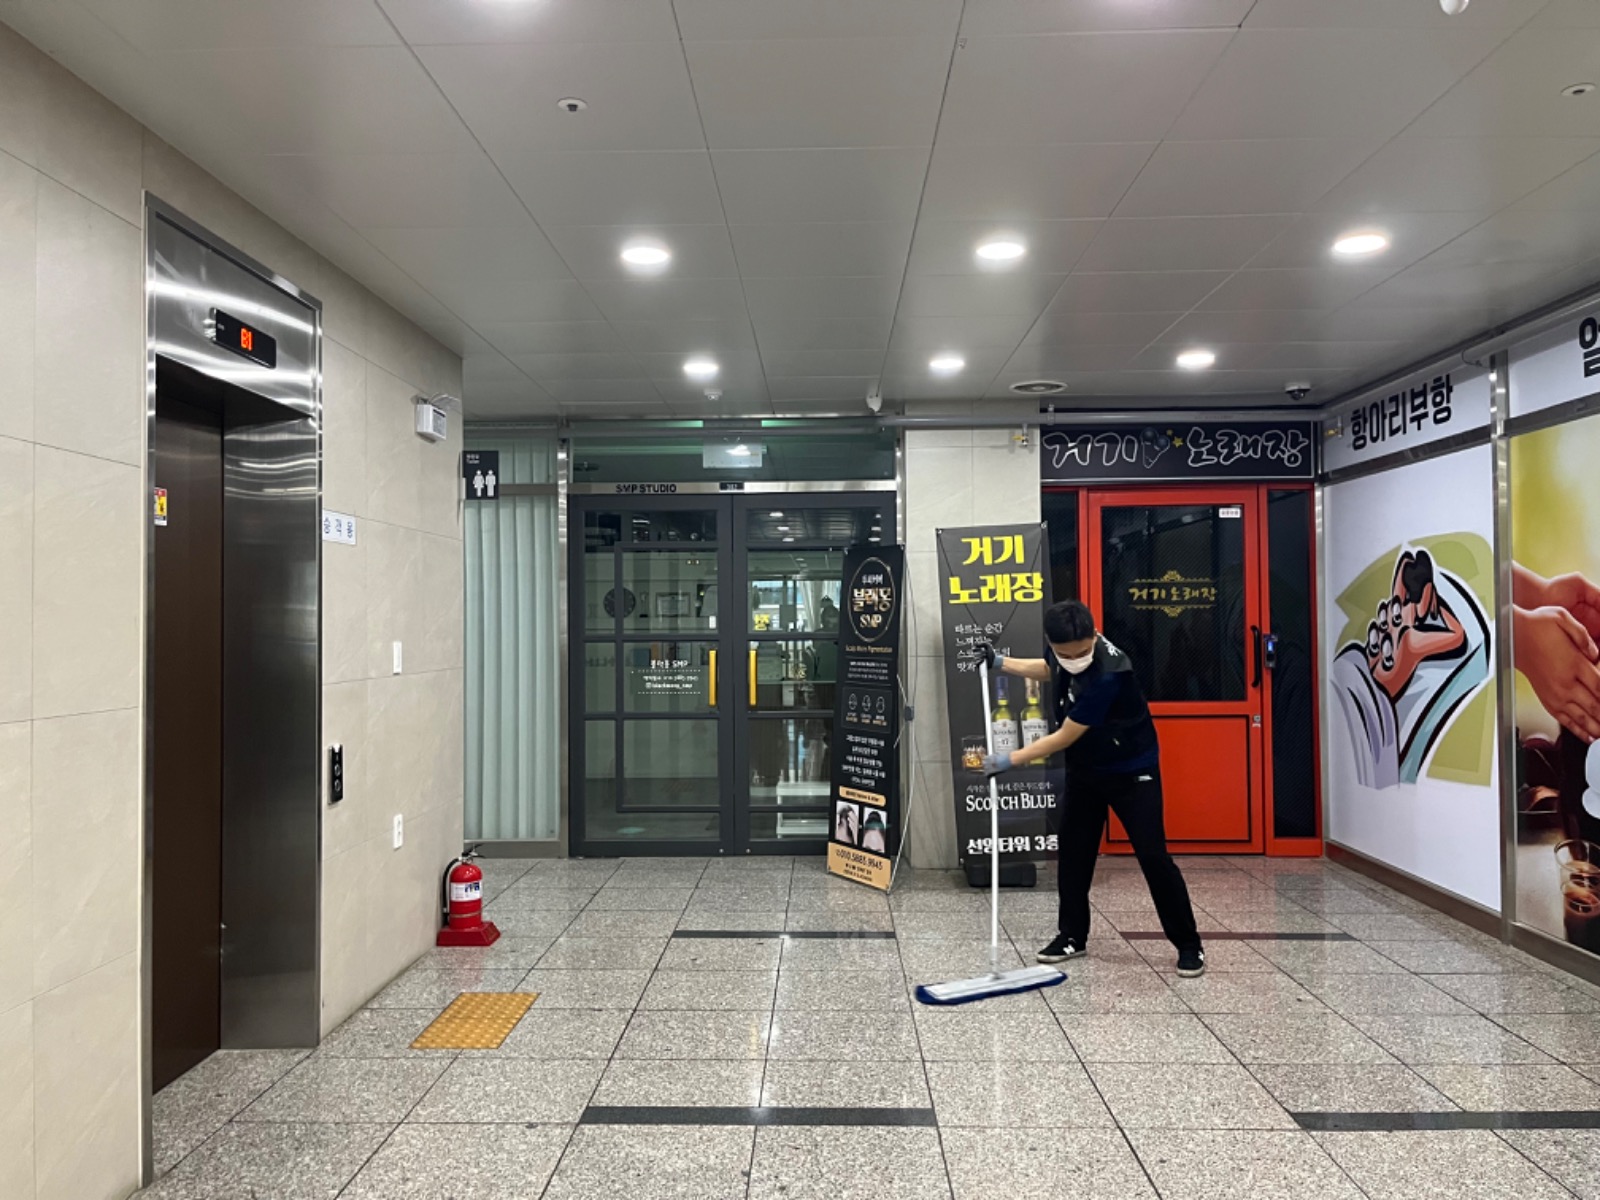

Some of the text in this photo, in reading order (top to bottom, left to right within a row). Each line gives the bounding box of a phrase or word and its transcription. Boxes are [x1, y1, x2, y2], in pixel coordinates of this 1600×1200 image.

[241, 328, 252, 351] B1
[1351, 374, 1453, 450] 항아리부항
[1042, 427, 1309, 468] 거기 노래장
[639, 483, 677, 493] STUDIO
[961, 534, 1024, 565] 거기
[949, 572, 1044, 604] 노래장
[1128, 586, 1218, 601] 거기 노래장
[1020, 792, 1057, 810] BLUE
